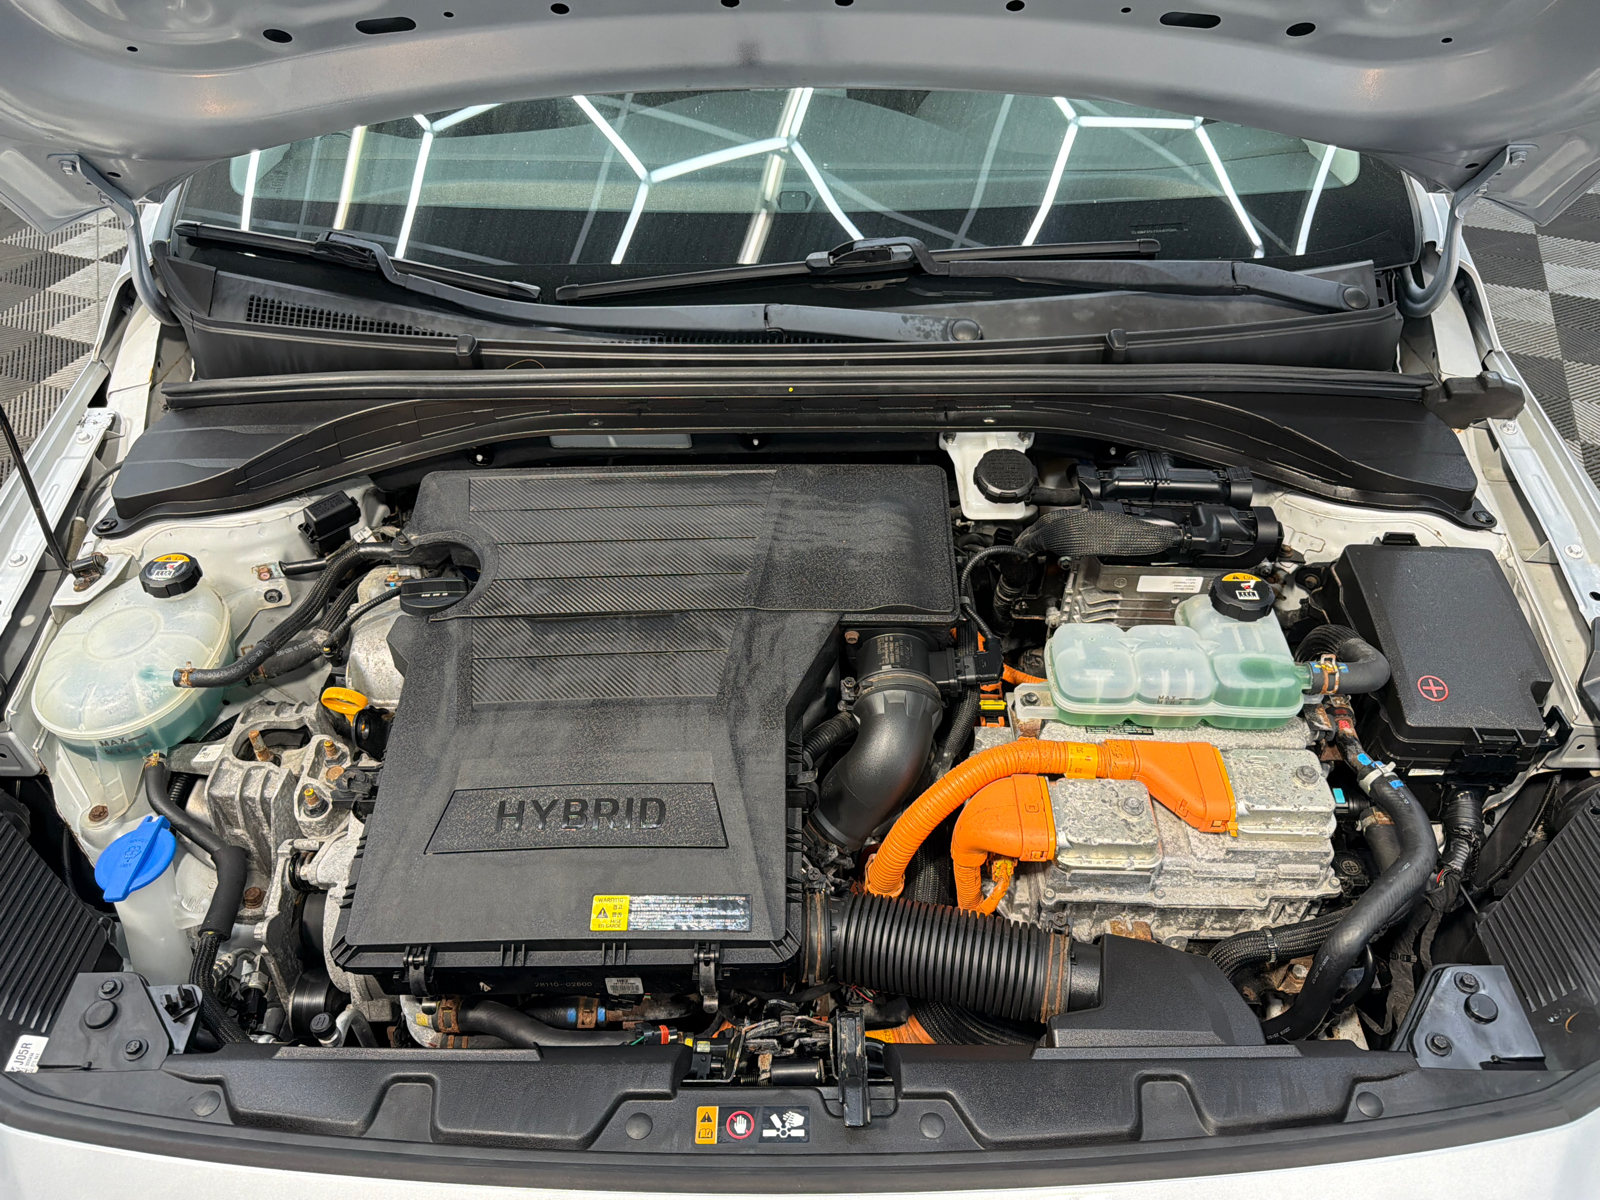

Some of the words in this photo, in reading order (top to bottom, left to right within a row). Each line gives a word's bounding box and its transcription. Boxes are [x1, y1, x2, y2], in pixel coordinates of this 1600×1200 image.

[99, 737, 127, 747] MAX
[495, 797, 667, 832] HYBRID
[13, 1042, 33, 1065] J05R
